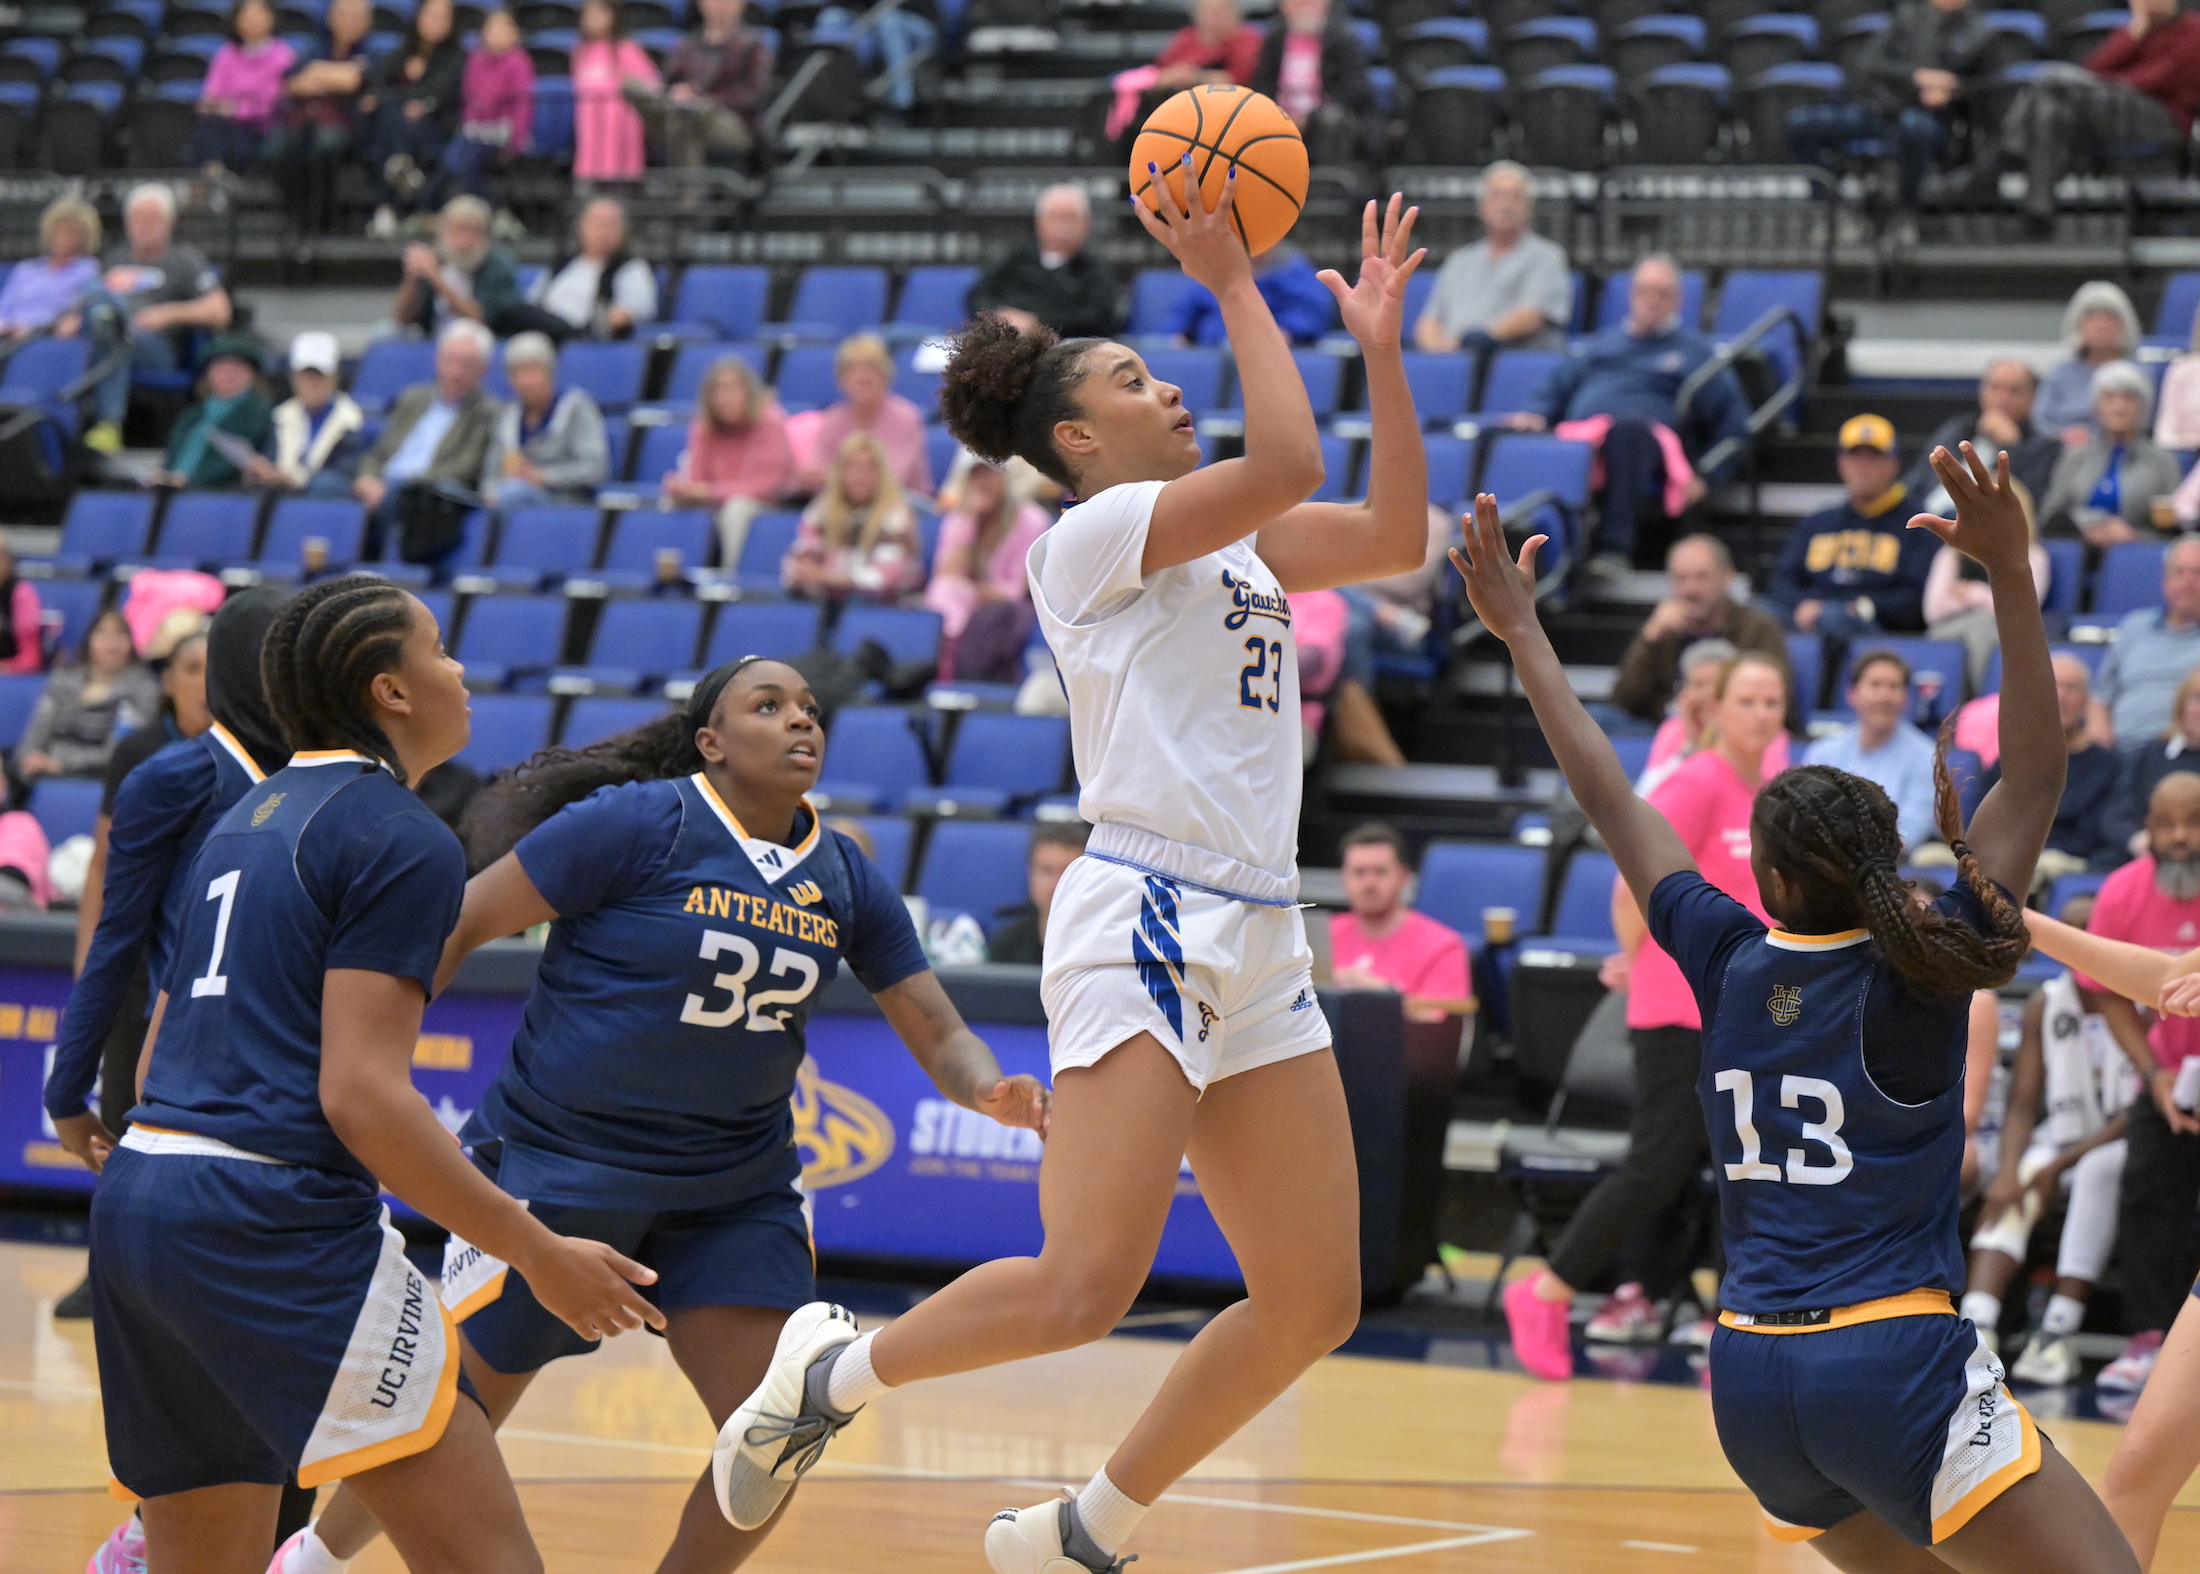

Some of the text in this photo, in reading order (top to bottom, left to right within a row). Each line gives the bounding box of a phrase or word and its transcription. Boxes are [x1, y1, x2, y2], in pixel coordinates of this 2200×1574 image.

[1221, 568, 1291, 630] Gaucho
[1238, 634, 1282, 716] 23
[191, 870, 241, 998] 1
[683, 886, 839, 948] ANTEATERS
[679, 928, 820, 1032] 32
[1290, 1000, 1313, 1012] adidas
[1715, 1068, 1854, 1186] 13
[371, 1271, 423, 1409] UC IRVINE
